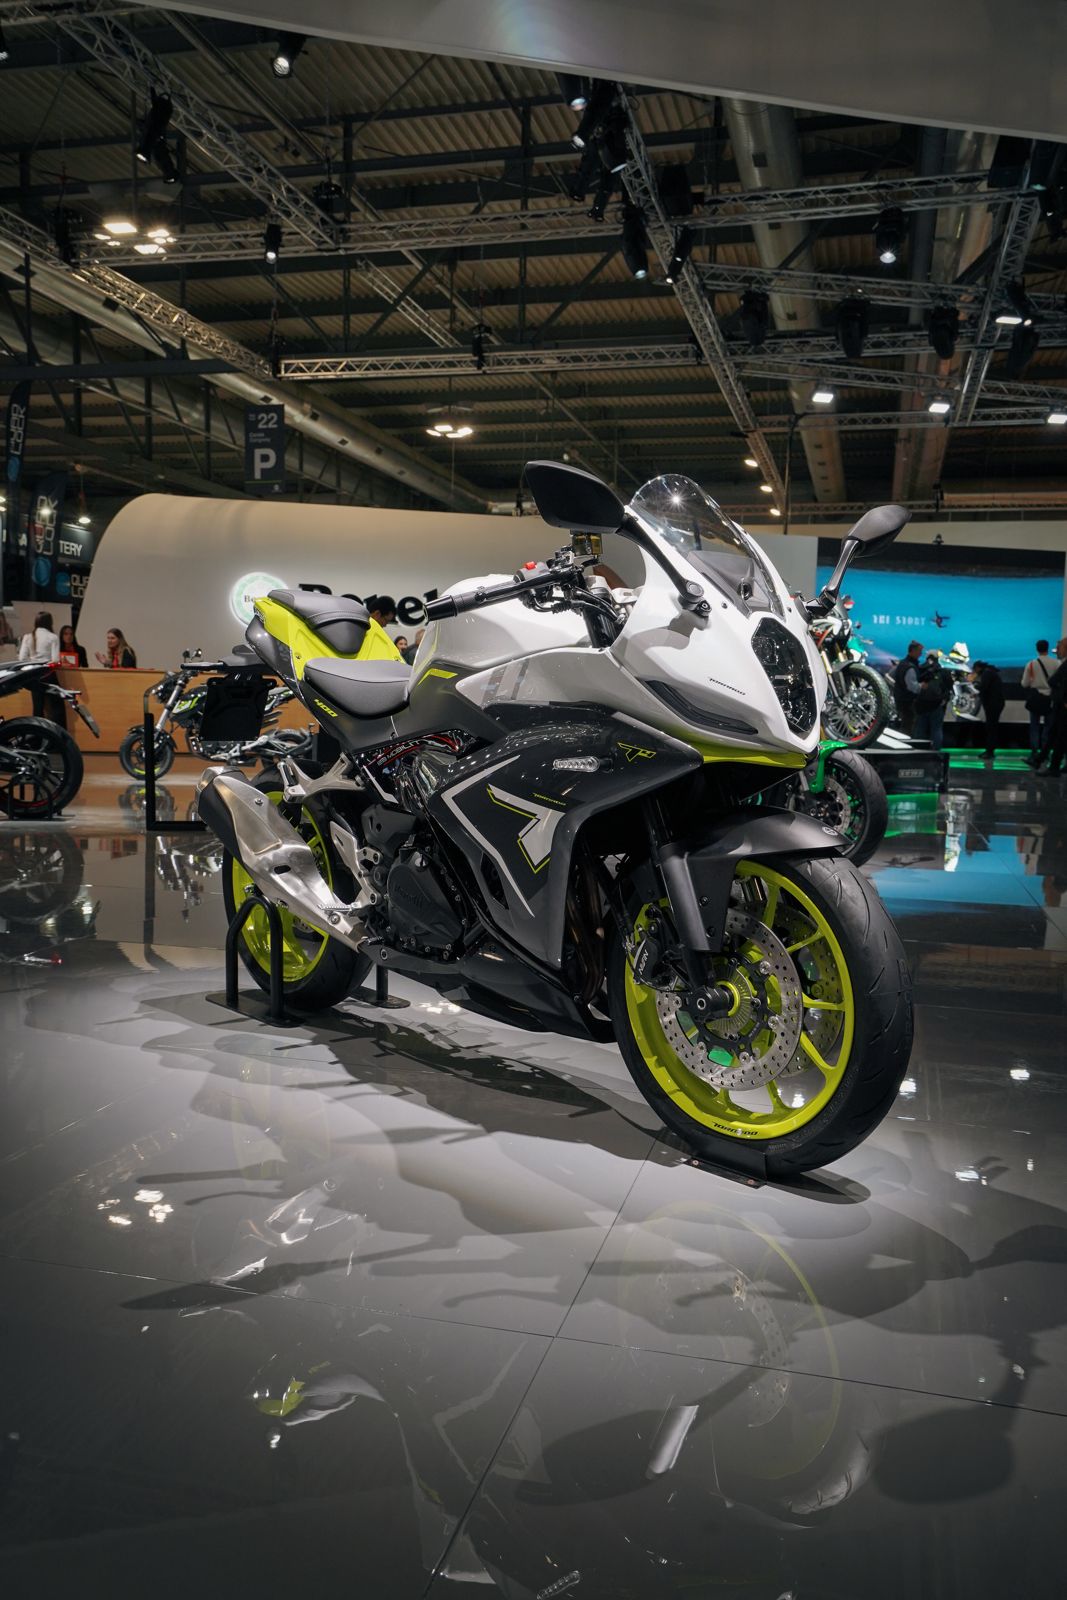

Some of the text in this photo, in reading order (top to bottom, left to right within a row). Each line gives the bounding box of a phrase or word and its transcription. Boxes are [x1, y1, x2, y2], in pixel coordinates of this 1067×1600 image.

[257, 412, 278, 429] 22
[253, 447, 277, 480] P
[314, 699, 338, 717] 400
[712, 1121, 759, 1136] TORNDO
